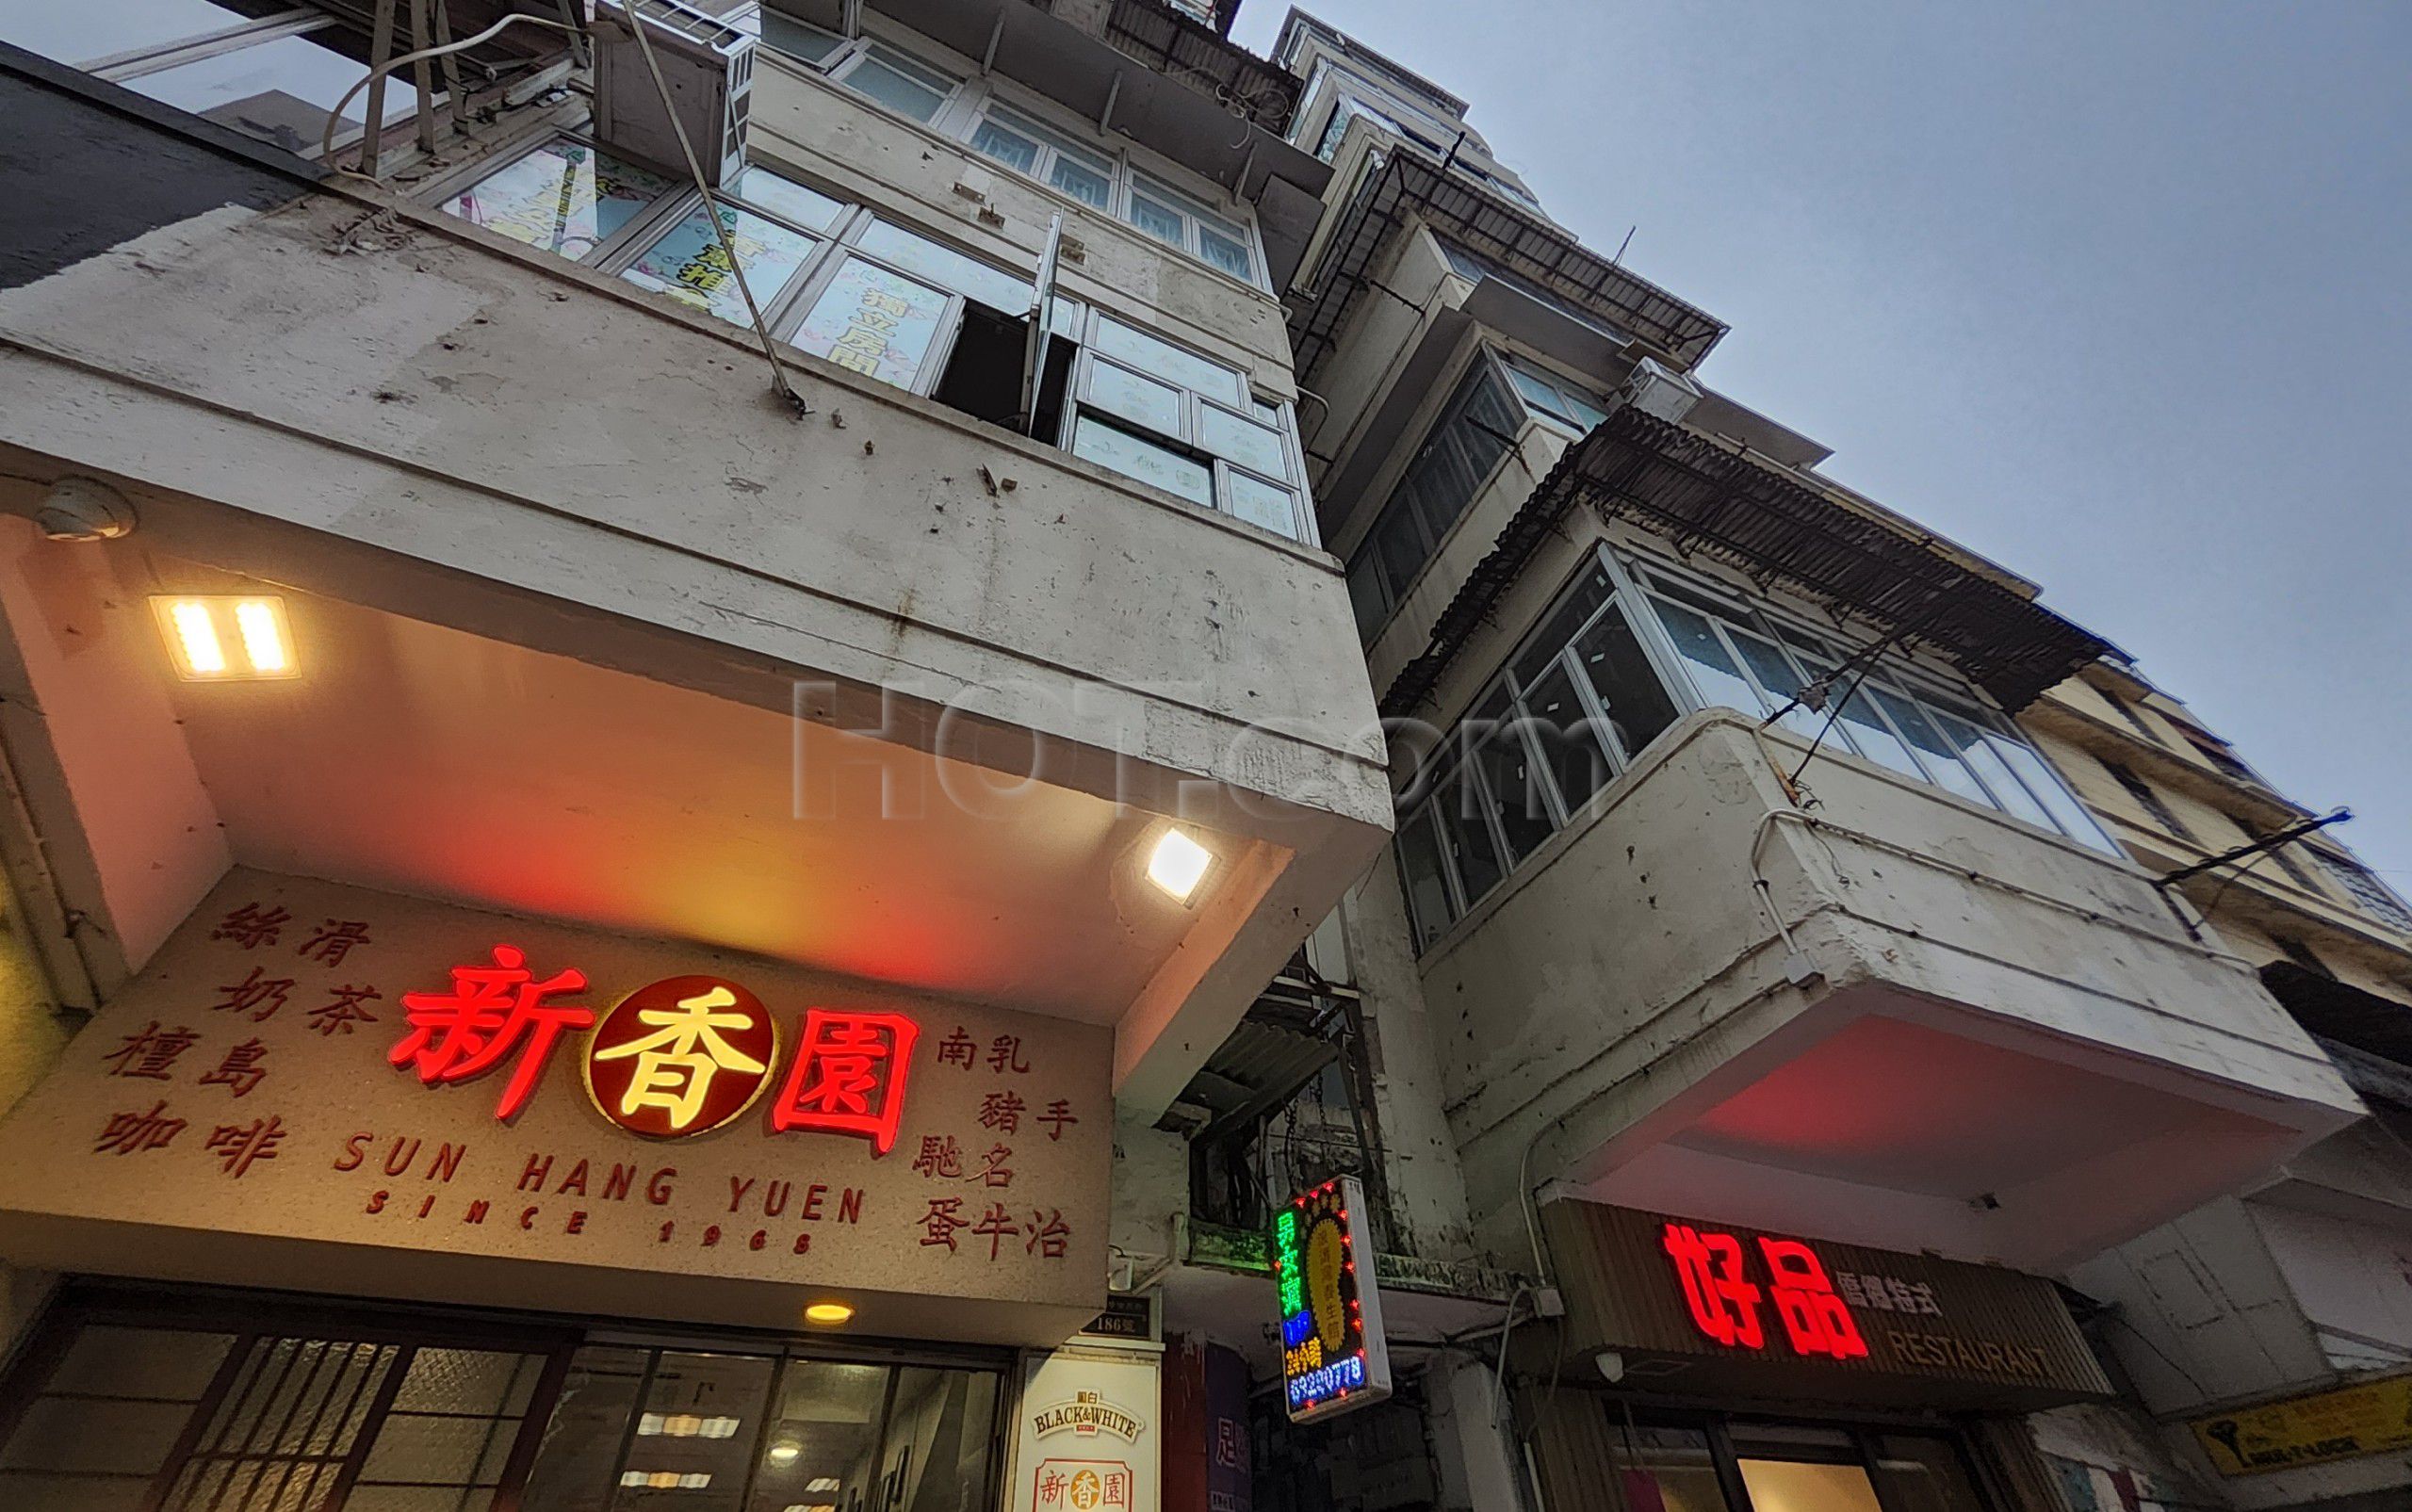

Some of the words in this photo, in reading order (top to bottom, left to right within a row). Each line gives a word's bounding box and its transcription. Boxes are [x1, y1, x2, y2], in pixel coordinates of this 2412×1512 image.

[388, 944, 921, 1155] 新香園
[334, 1131, 467, 1183] SUN
[516, 1152, 677, 1206] HANG
[726, 1175, 864, 1225] YUEN
[365, 1190, 589, 1235] SINCE
[659, 1220, 811, 1256] 1968
[1664, 1224, 1868, 1360] 好品
[1887, 1329, 2053, 1381] RESTAURANT
[1040, 1469, 1126, 1511] 新香園
